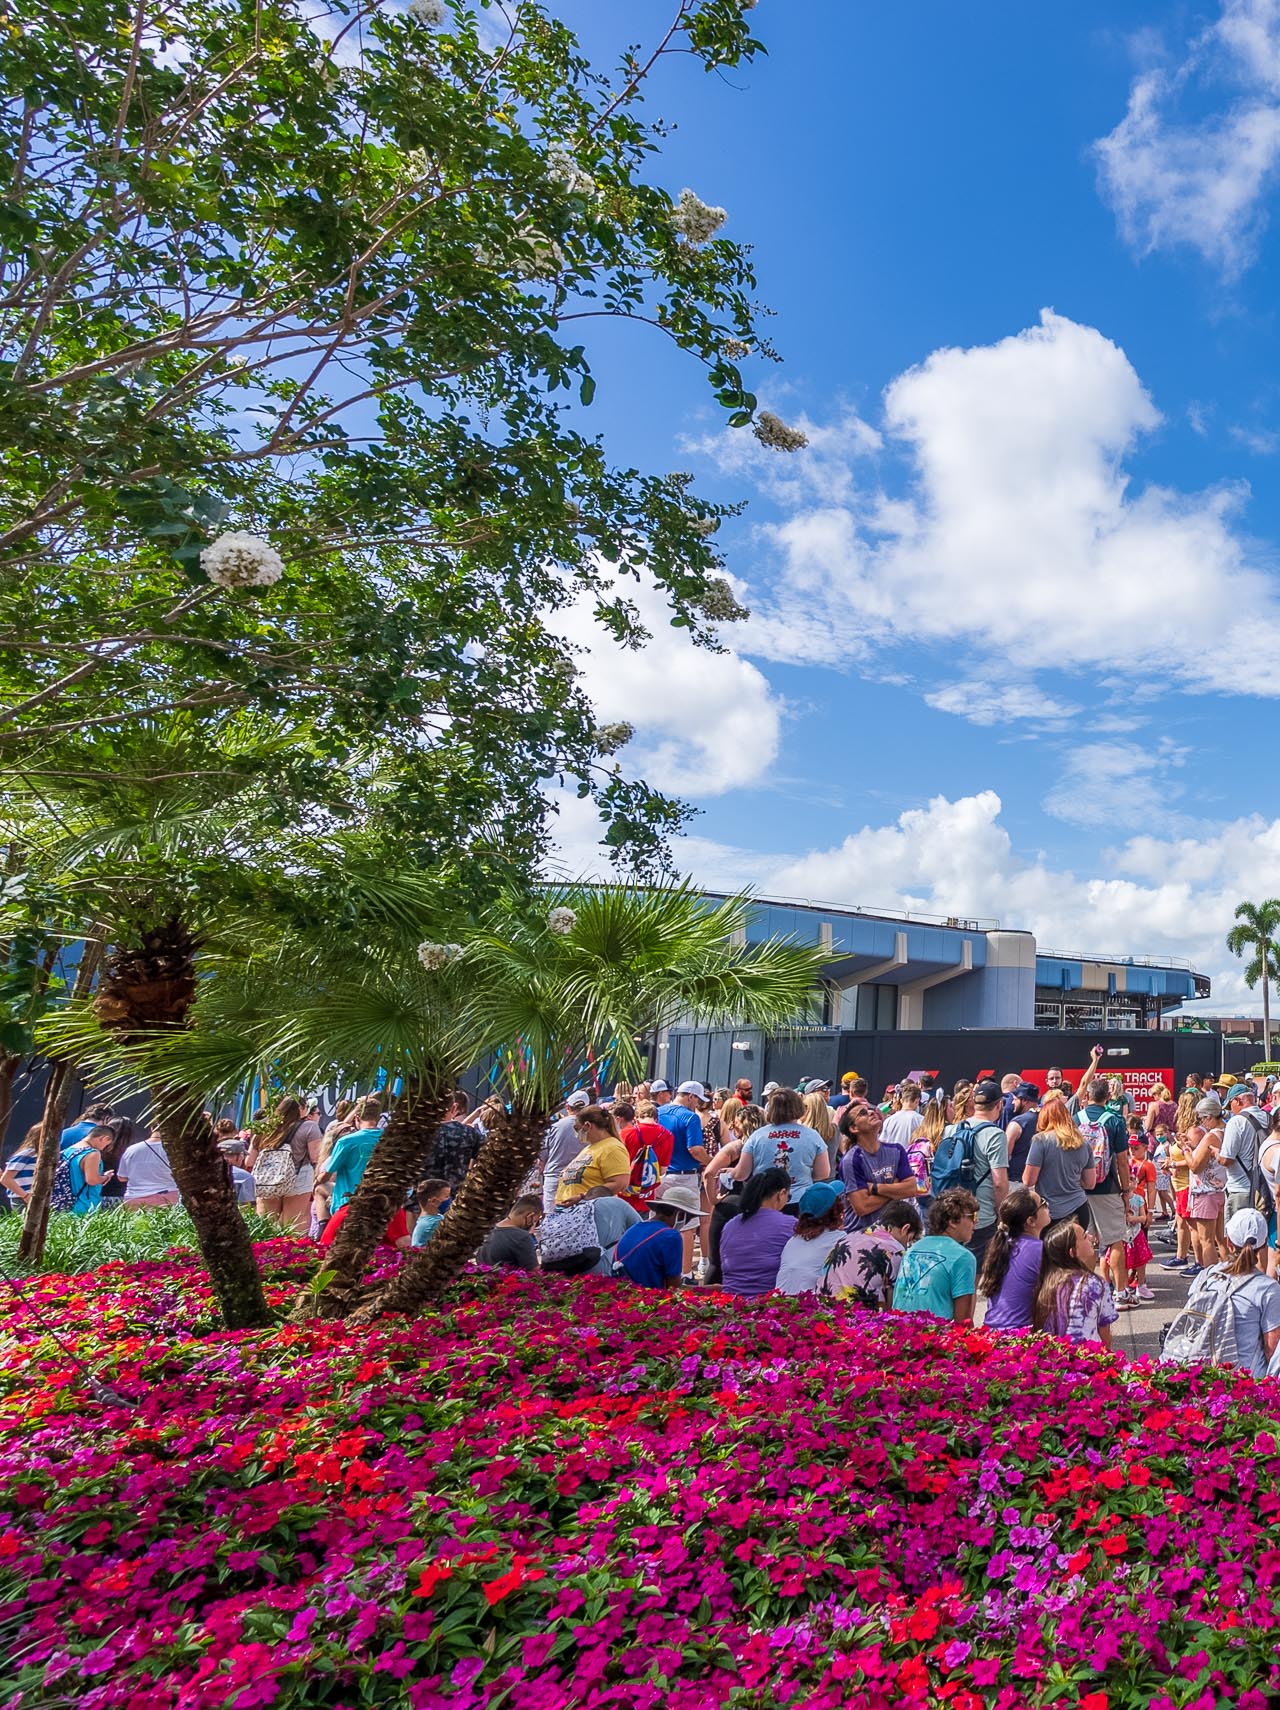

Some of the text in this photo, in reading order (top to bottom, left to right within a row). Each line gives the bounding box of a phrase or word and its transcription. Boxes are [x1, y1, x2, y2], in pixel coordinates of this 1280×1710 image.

[1094, 1072, 1163, 1082] TET TRACK
[1125, 1087, 1154, 1097] SPAC
